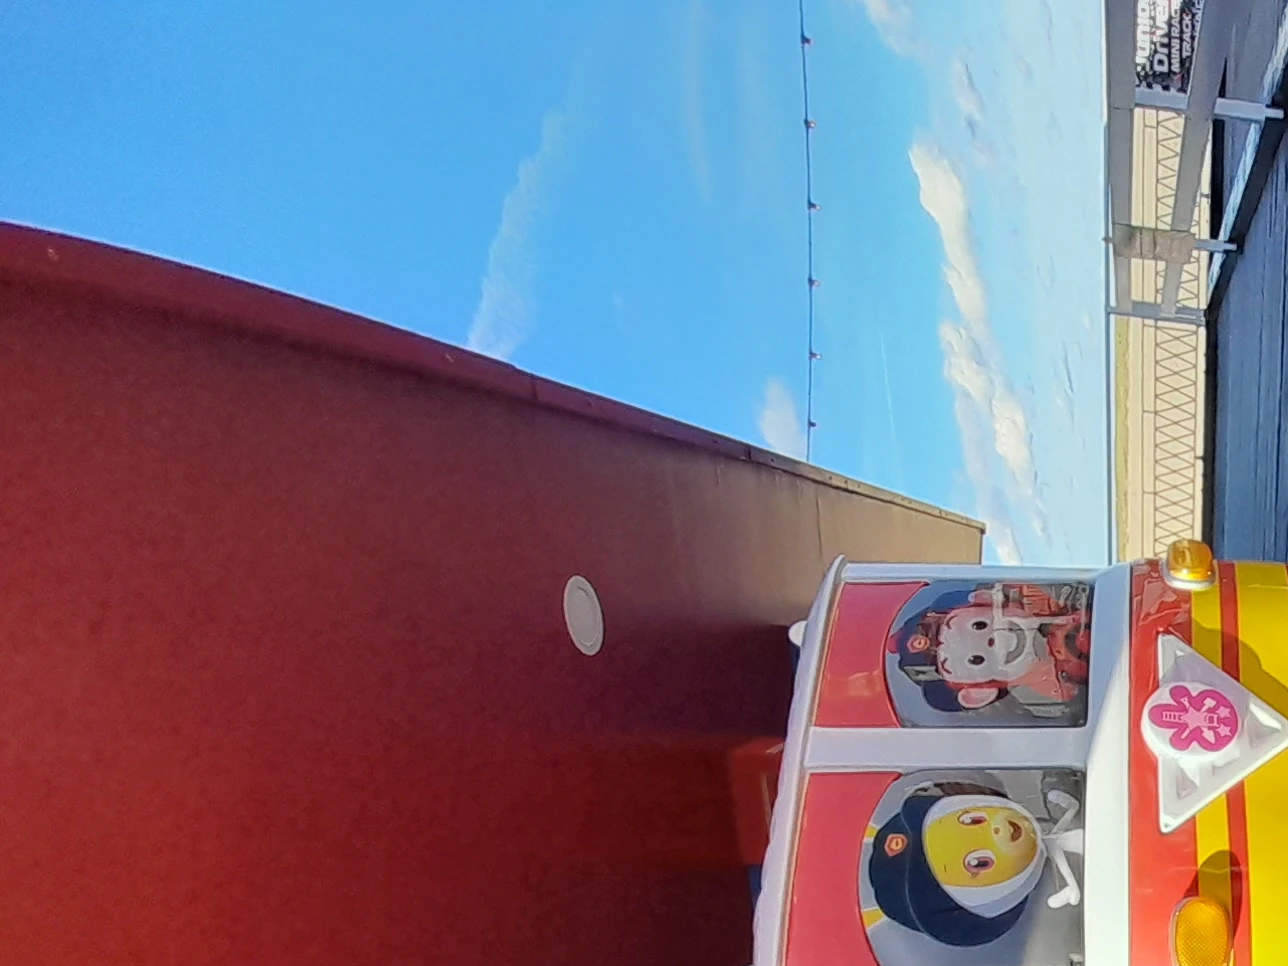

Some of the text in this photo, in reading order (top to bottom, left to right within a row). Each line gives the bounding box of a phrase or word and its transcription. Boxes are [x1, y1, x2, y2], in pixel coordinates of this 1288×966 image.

[1135, 0, 1150, 71] Junio
[1170, 39, 1180, 72] MINI
[1182, 12, 1193, 58] TRACK
